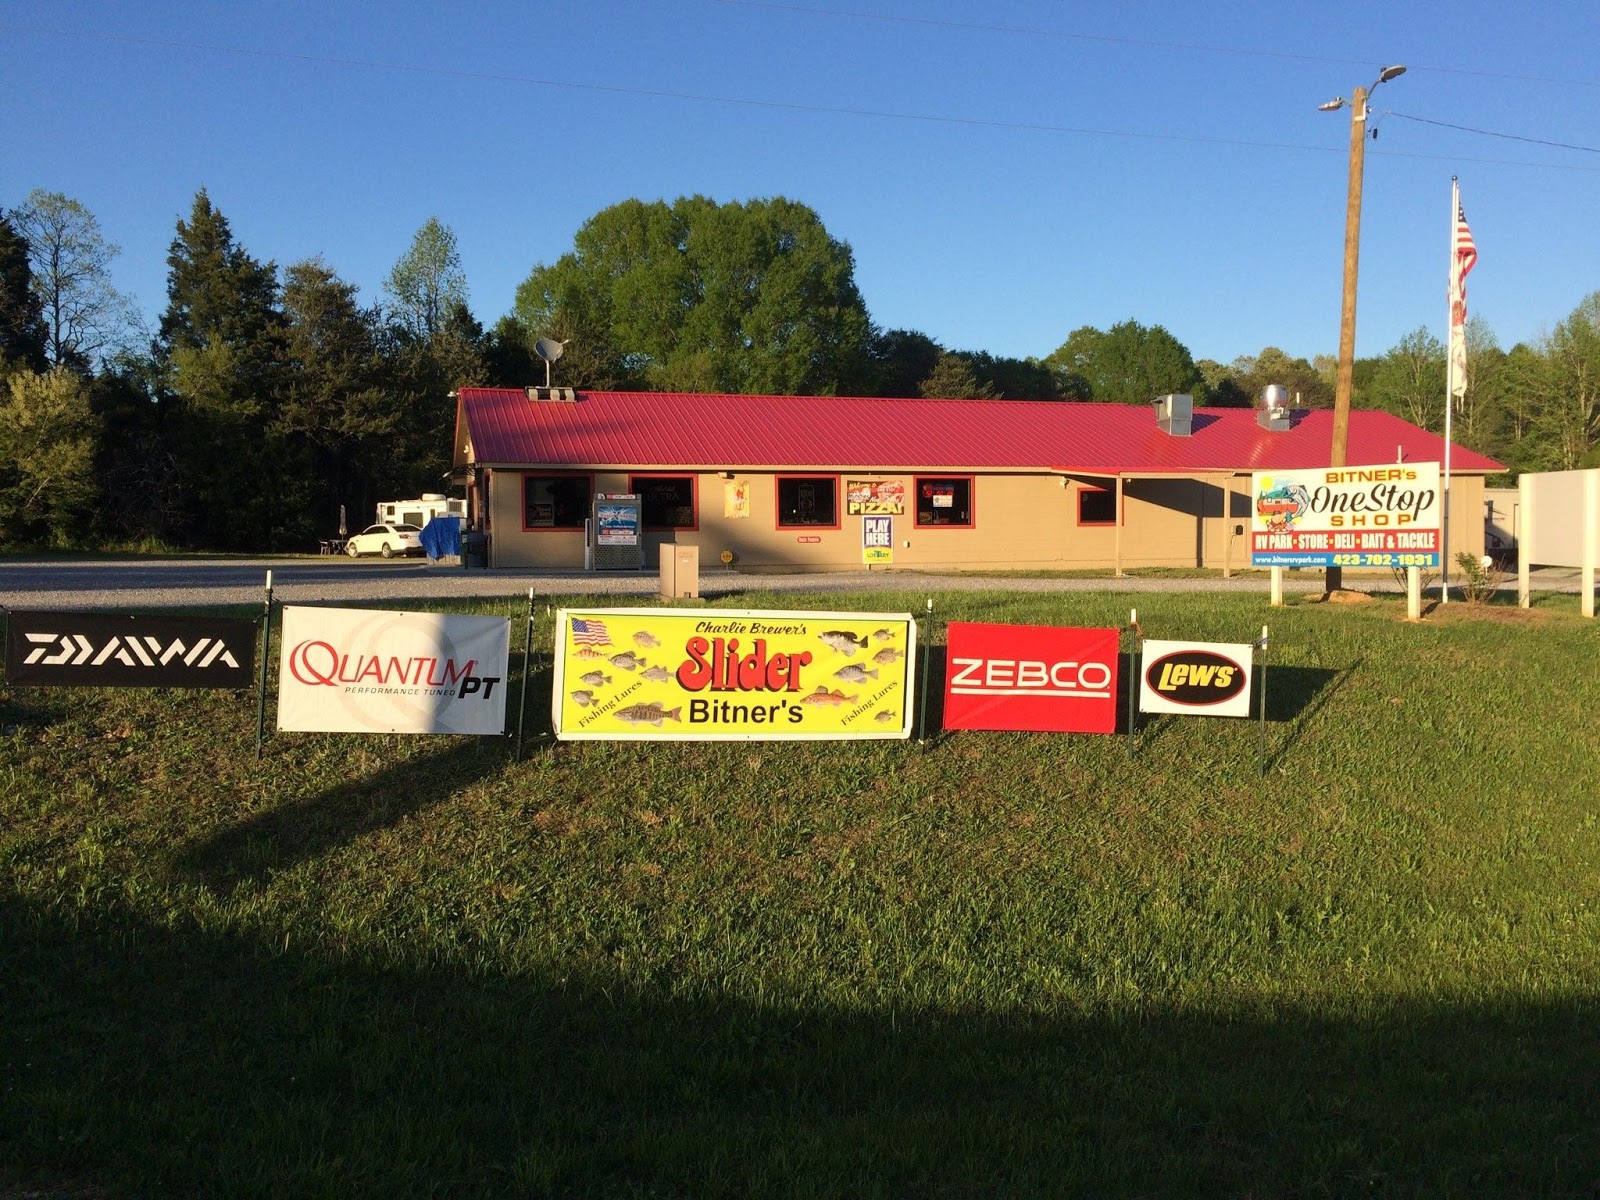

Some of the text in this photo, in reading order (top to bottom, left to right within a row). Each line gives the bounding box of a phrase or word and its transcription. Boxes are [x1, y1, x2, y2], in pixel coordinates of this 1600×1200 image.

[1326, 469, 1417, 484] BITNER's
[1311, 483, 1435, 521] OneStop
[866, 519, 890, 532] PLAY
[1331, 513, 1411, 526] SHOP
[866, 532, 889, 546] HERE
[1255, 532, 1435, 549] RV PARK STORE DELI BAIT & TACKLE
[1333, 553, 1433, 566] 423-702-1931
[695, 621, 807, 635] Charlie Brewer's
[23, 633, 240, 668] DAIWA
[676, 636, 813, 692] Slider
[951, 658, 1112, 689] ZEBCO
[345, 686, 456, 697] PERFORMANCE TUNED
[458, 677, 501, 700] PT
[578, 681, 643, 728] Fishing Lures
[689, 699, 803, 724] Bitner's
[841, 681, 898, 726] Fishing Lures
